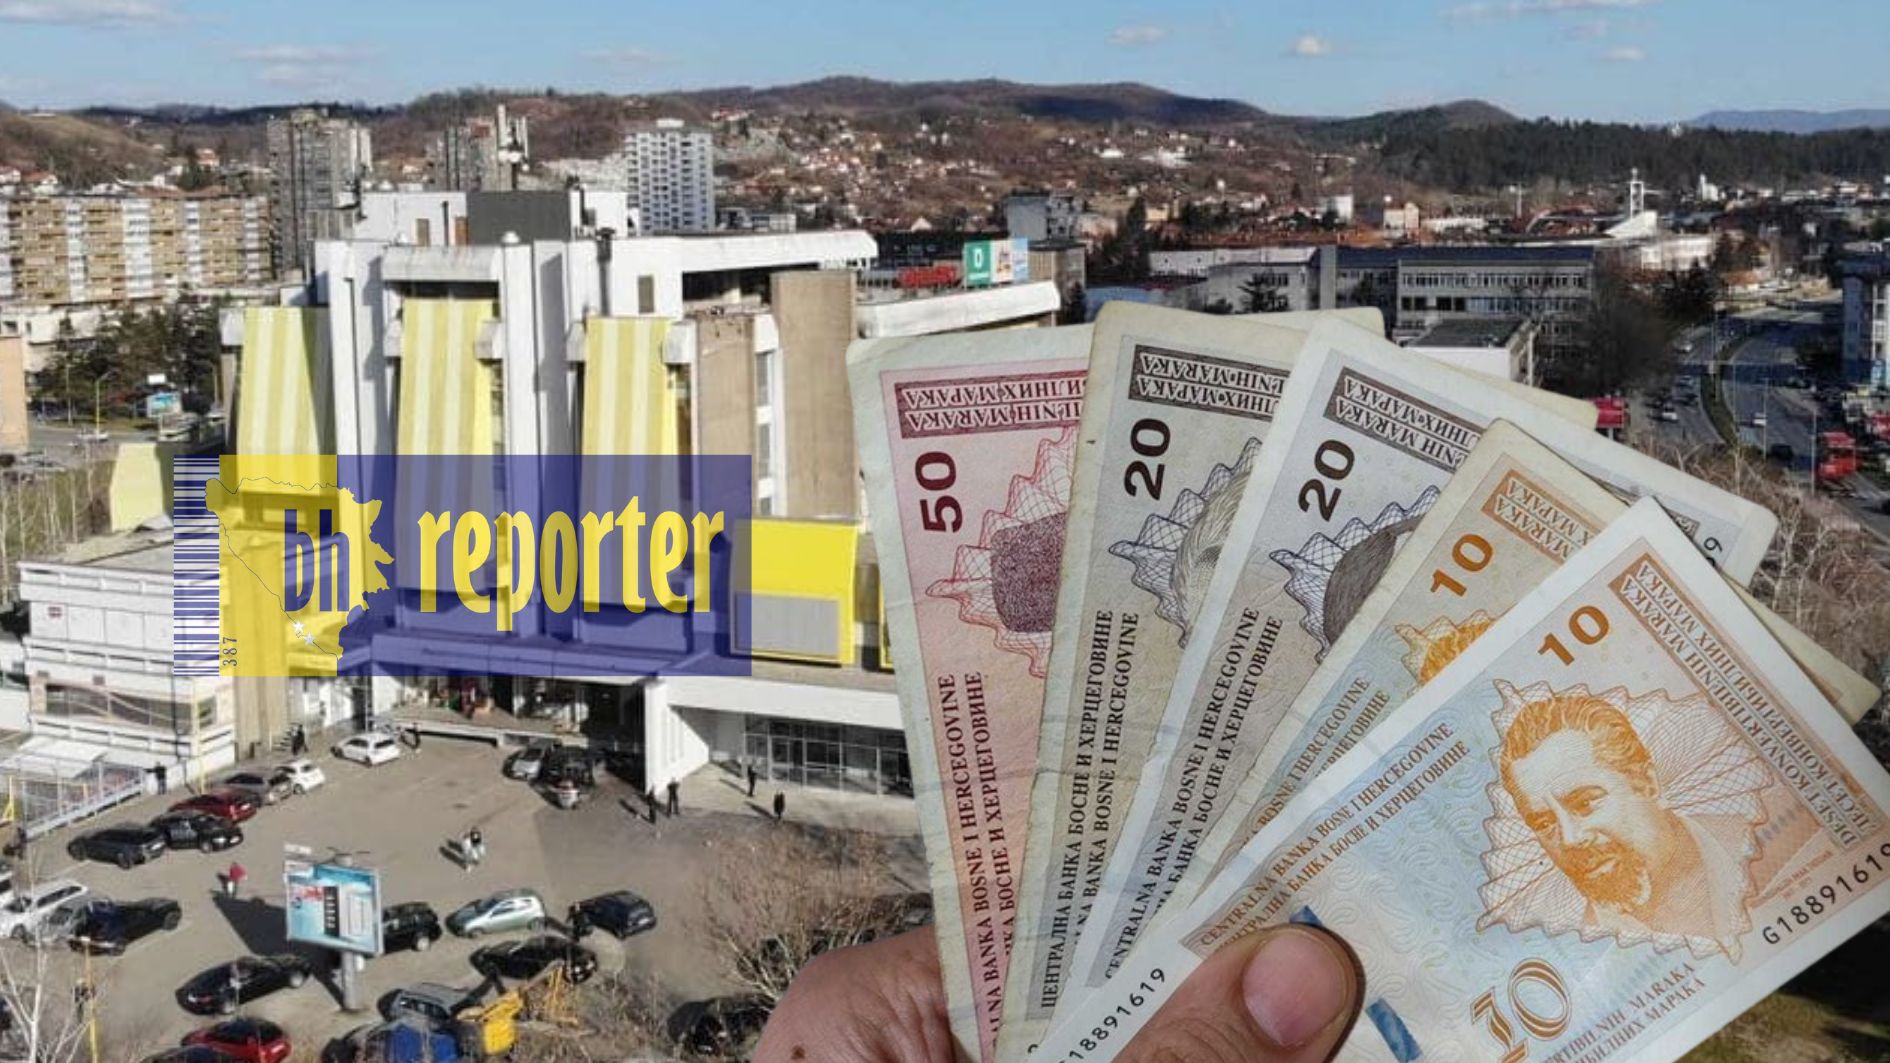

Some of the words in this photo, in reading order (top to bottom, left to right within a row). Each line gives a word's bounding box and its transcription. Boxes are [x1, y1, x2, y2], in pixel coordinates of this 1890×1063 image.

[902, 382, 1000, 409] МАРАКА
[1137, 374, 1221, 406] МАРАКА
[1140, 352, 1230, 385] MARAKA
[1344, 375, 1421, 425] МАРАКА
[905, 405, 1011, 432] MARAKA
[1335, 396, 1420, 448] MARAKA
[915, 451, 962, 534] 50
[1124, 419, 1171, 502] 20
[1298, 439, 1355, 522] 20
[1494, 495, 1574, 559] MARAKA
[1507, 478, 1579, 537] МАРАКА
[1430, 533, 1493, 597] 10
[1620, 575, 1689, 654] MARAKA
[1636, 560, 1699, 635] МАРАКА
[1538, 606, 1609, 666] 10
[1078, 609, 1114, 749] ХЕРЦЕГОВИНЕ
[1103, 612, 1139, 753] HERCEGOVINE
[938, 673, 977, 828] HERCEGOVINE
[964, 671, 1003, 823] ХЕРЦЕГОВИНЕ
[1146, 818, 1183, 878] BANKA
[1172, 753, 1204, 814] BOSNE
[1198, 607, 1260, 741] HERCEGOVINE
[1193, 762, 1225, 823] БОСНЕ
[1221, 615, 1283, 745] ХЕРЦЕГОВИНЕ
[1294, 677, 1371, 774] HERCEGOVINE
[1076, 754, 1093, 767] И
[1101, 757, 1118, 765] I
[1068, 772, 1090, 835] БОСНЕ
[1093, 770, 1116, 832] BOSNE
[1287, 851, 1334, 892] БАНКА
[1329, 824, 1370, 857] БОСНЕ
[1375, 740, 1471, 824] ХЕРЦЕГОВИНЕ
[963, 833, 980, 843] I
[988, 827, 1006, 842] И
[1200, 873, 1278, 946] CENTRALNA
[1273, 835, 1321, 878] BANKA
[1315, 804, 1355, 838] BOSNE
[1357, 722, 1455, 806] HERCEGOVINE
[965, 847, 990, 912] BOSNE
[992, 847, 1015, 912] БОСНЕ
[1057, 841, 1082, 900] БАНКА
[1082, 838, 1107, 898] BANKA
[978, 916, 1000, 983] BANKA
[1059, 968, 1166, 1063] 18891619
[1470, 956, 1572, 1063] 10
[1628, 961, 1695, 1010] MARAKA
